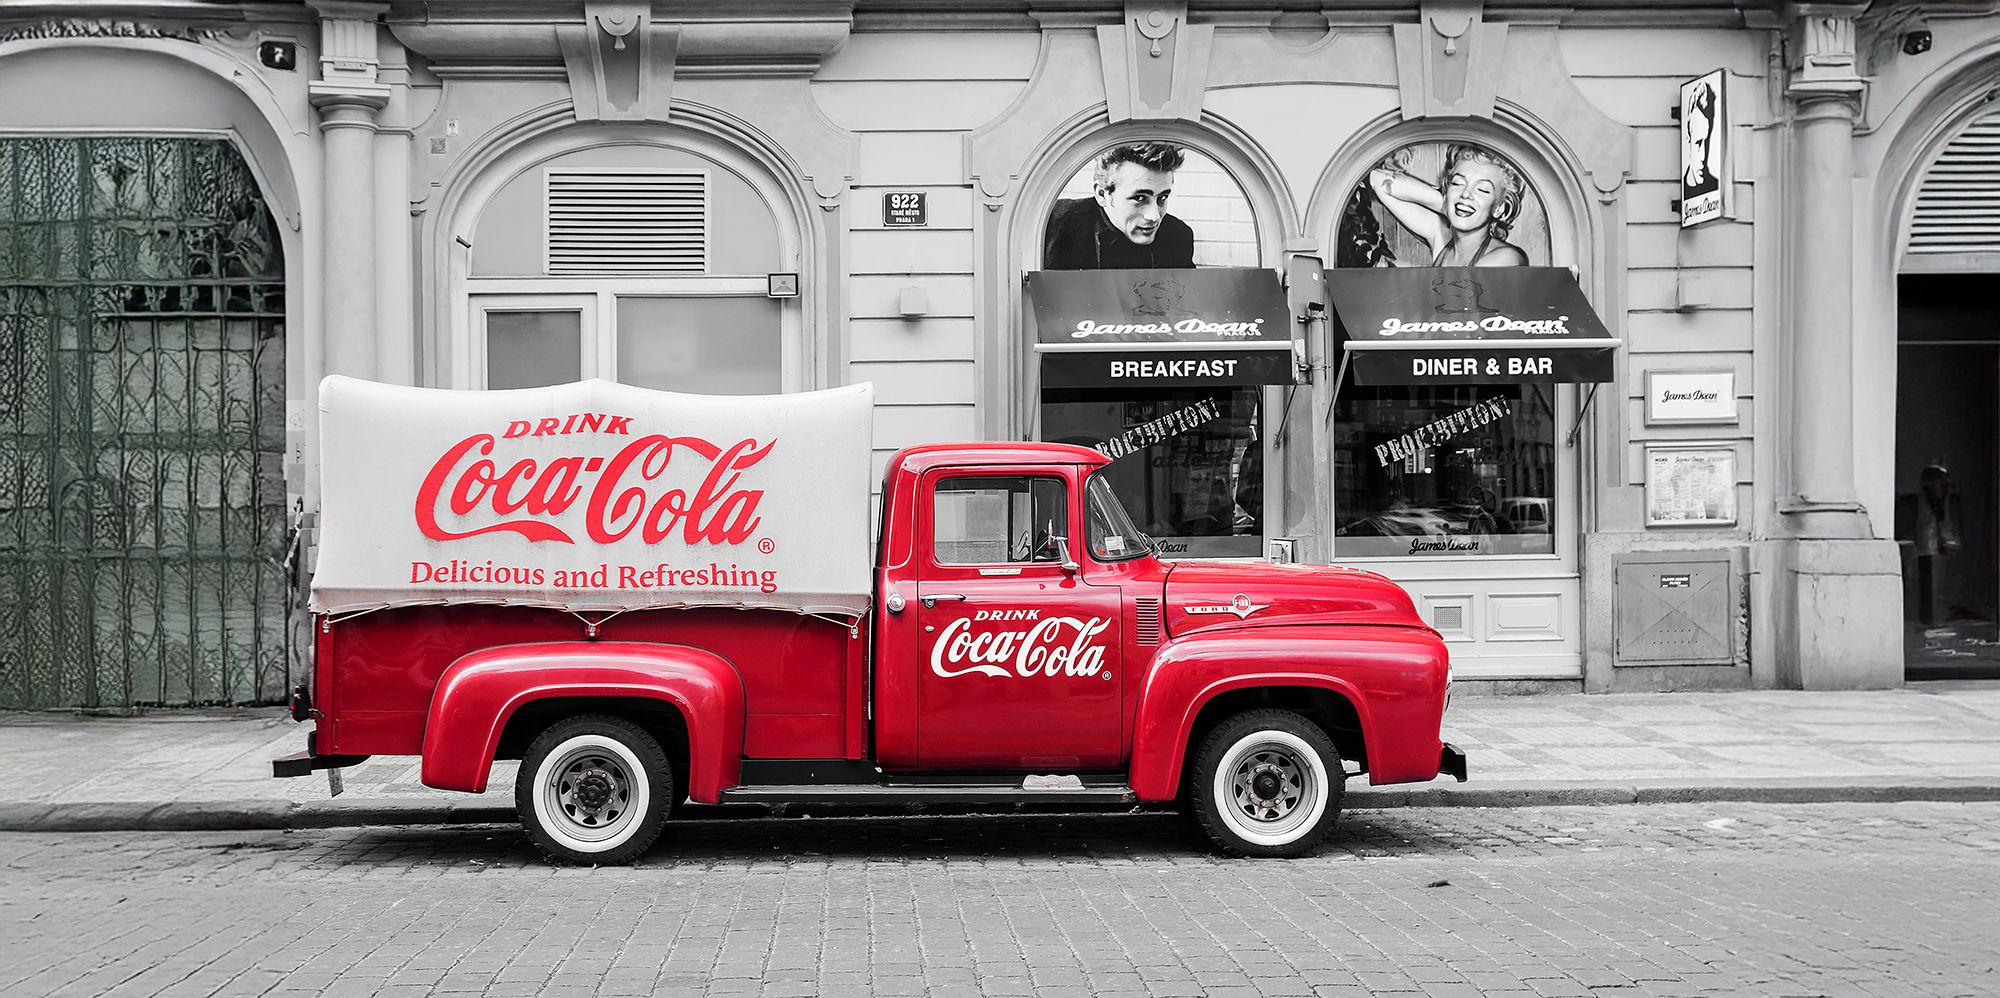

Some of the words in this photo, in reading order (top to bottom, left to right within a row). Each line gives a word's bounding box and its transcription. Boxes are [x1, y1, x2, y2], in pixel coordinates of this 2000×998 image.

[891, 194, 919, 208] 922
[1683, 203, 1702, 225] James
[1703, 197, 1719, 214] Dean
[1071, 319, 1173, 338] James
[1174, 318, 1258, 334] Dean
[1379, 317, 1479, 336] James
[1480, 316, 1565, 332] Dean
[1110, 360, 1238, 378] BREAKFAST
[1412, 358, 1478, 376] DINER
[1485, 358, 1501, 375] &
[1508, 357, 1553, 375] BAR
[1662, 390, 1692, 403] James
[1692, 389, 1718, 400] Dean
[502, 412, 634, 439] DRINK
[1095, 397, 1220, 459] ROHIBITION!
[415, 433, 777, 545] Coca-Cola
[1157, 539, 1188, 552] Dean
[1409, 538, 1446, 554] James
[1448, 538, 1480, 551] Dean
[410, 559, 545, 585] Delicious
[553, 564, 608, 588] and
[618, 563, 777, 593] Refreshing
[974, 609, 1041, 621] DRINK
[931, 616, 1112, 678] Coca-Cola
